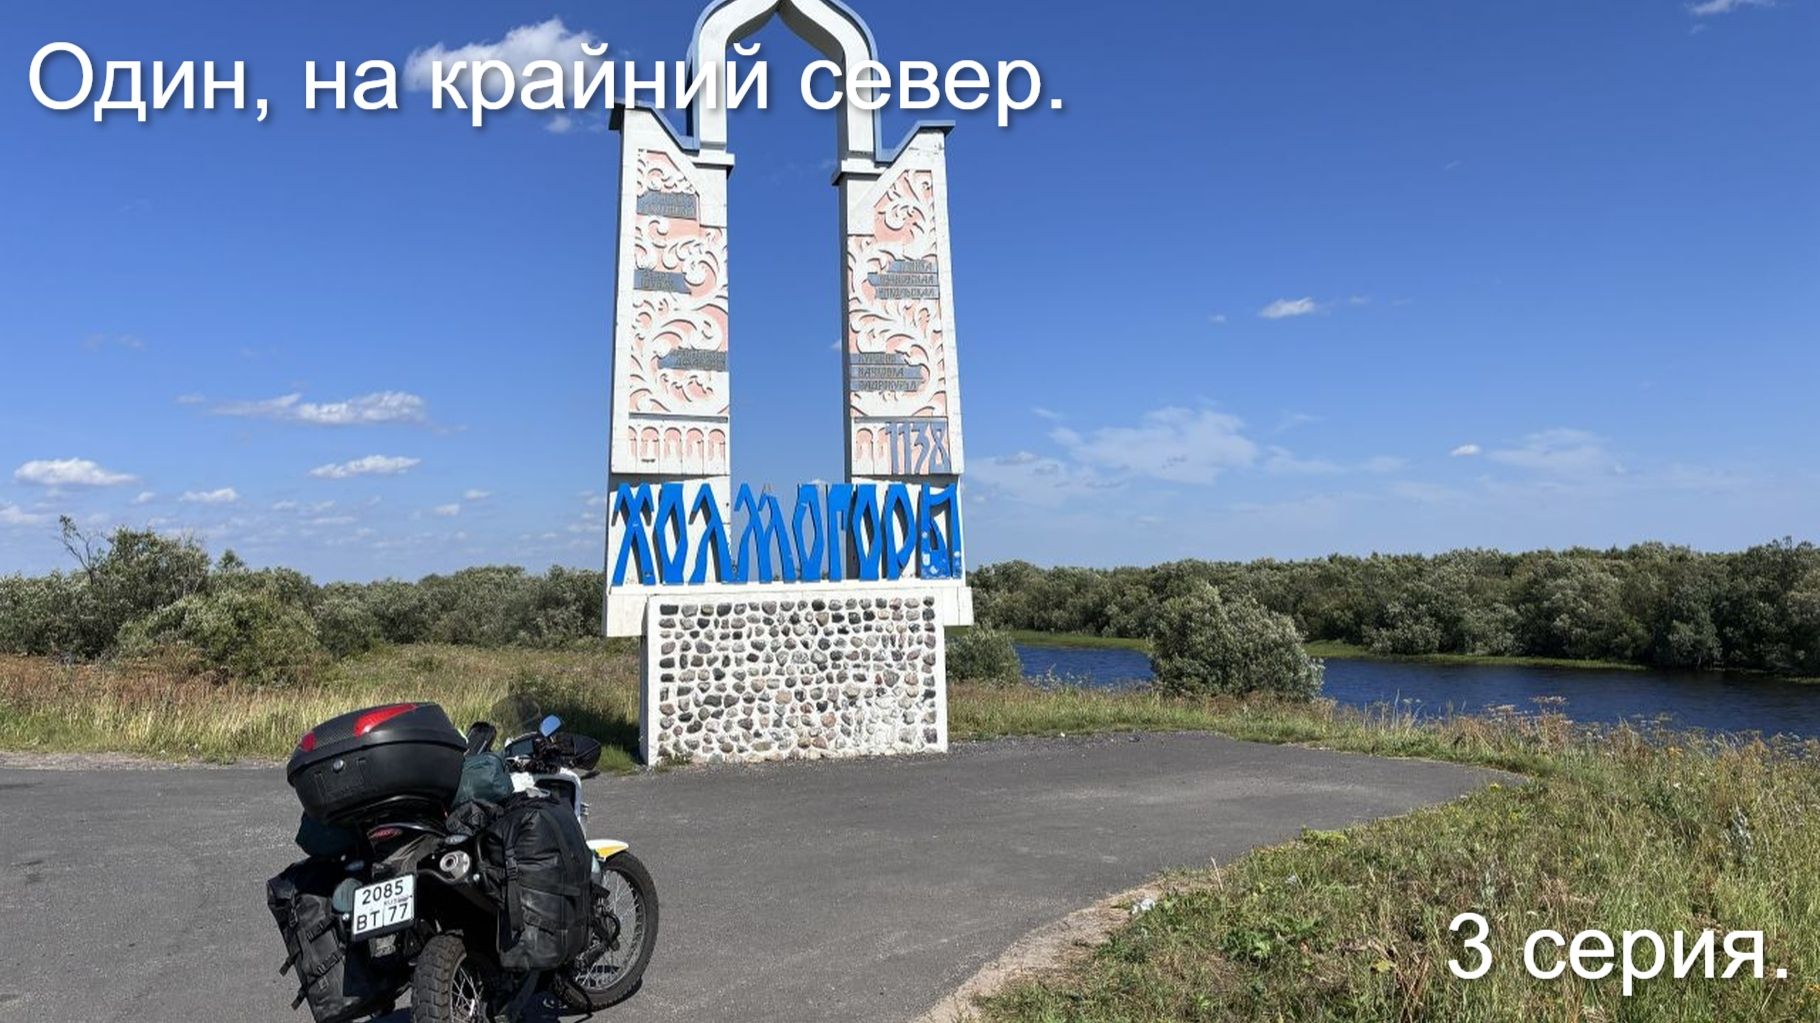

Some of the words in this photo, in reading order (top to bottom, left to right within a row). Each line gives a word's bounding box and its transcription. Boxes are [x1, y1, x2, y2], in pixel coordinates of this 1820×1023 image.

[885, 421, 952, 475] 1138
[611, 482, 962, 585] ХОЛМОГОРЫ
[362, 879, 404, 905] 2085
[388, 902, 408, 922] 77
